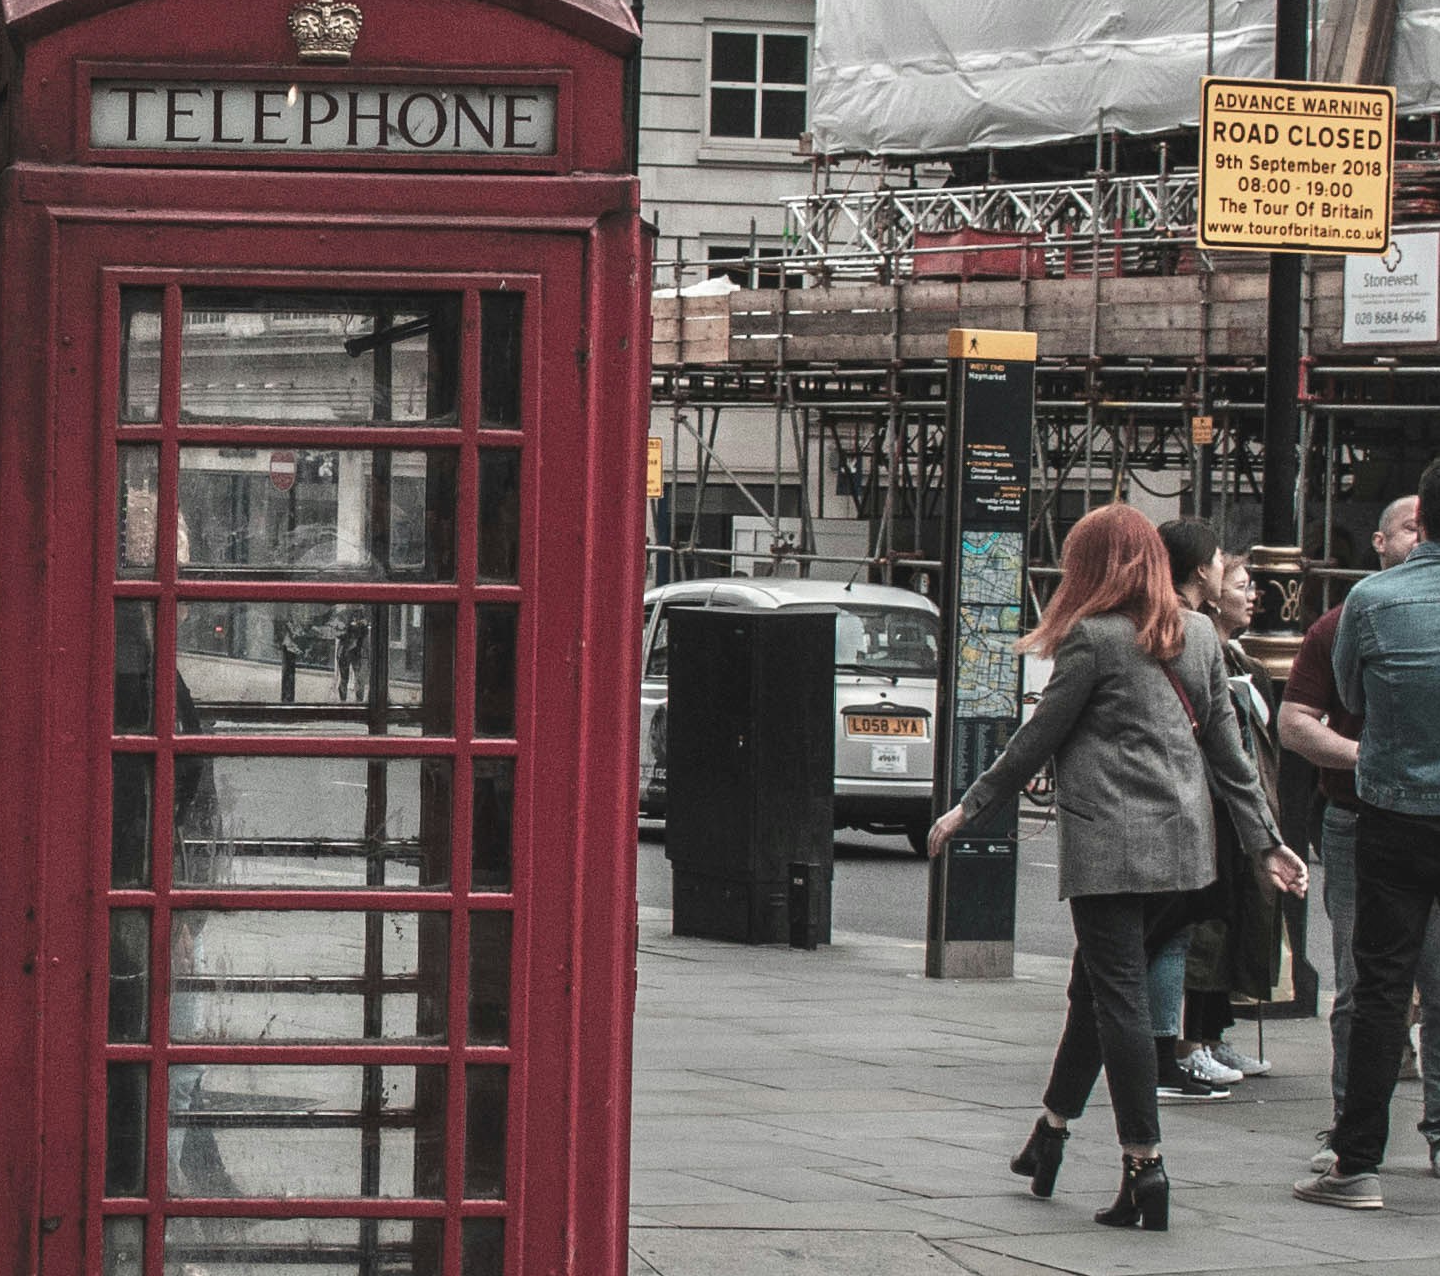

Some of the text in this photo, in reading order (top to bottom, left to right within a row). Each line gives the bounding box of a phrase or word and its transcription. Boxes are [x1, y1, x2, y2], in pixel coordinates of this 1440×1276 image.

[1214, 92, 1384, 117] ADVANCE WARNING
[109, 86, 540, 149] TELEPHONE
[1213, 121, 1382, 150] ROAD CLOSED
[1215, 153, 1382, 177] 9th September 2018
[1238, 177, 1290, 194] 08:00
[1306, 181, 1353, 198] 19:00
[1219, 197, 1374, 220] The Tour Of Britain
[1207, 221, 1383, 241] www.tourofbritain.co.uk
[1363, 272, 1419, 288] Stonewest
[968, 372, 1007, 382] Haymarket
[893, 719, 919, 734] JYA
